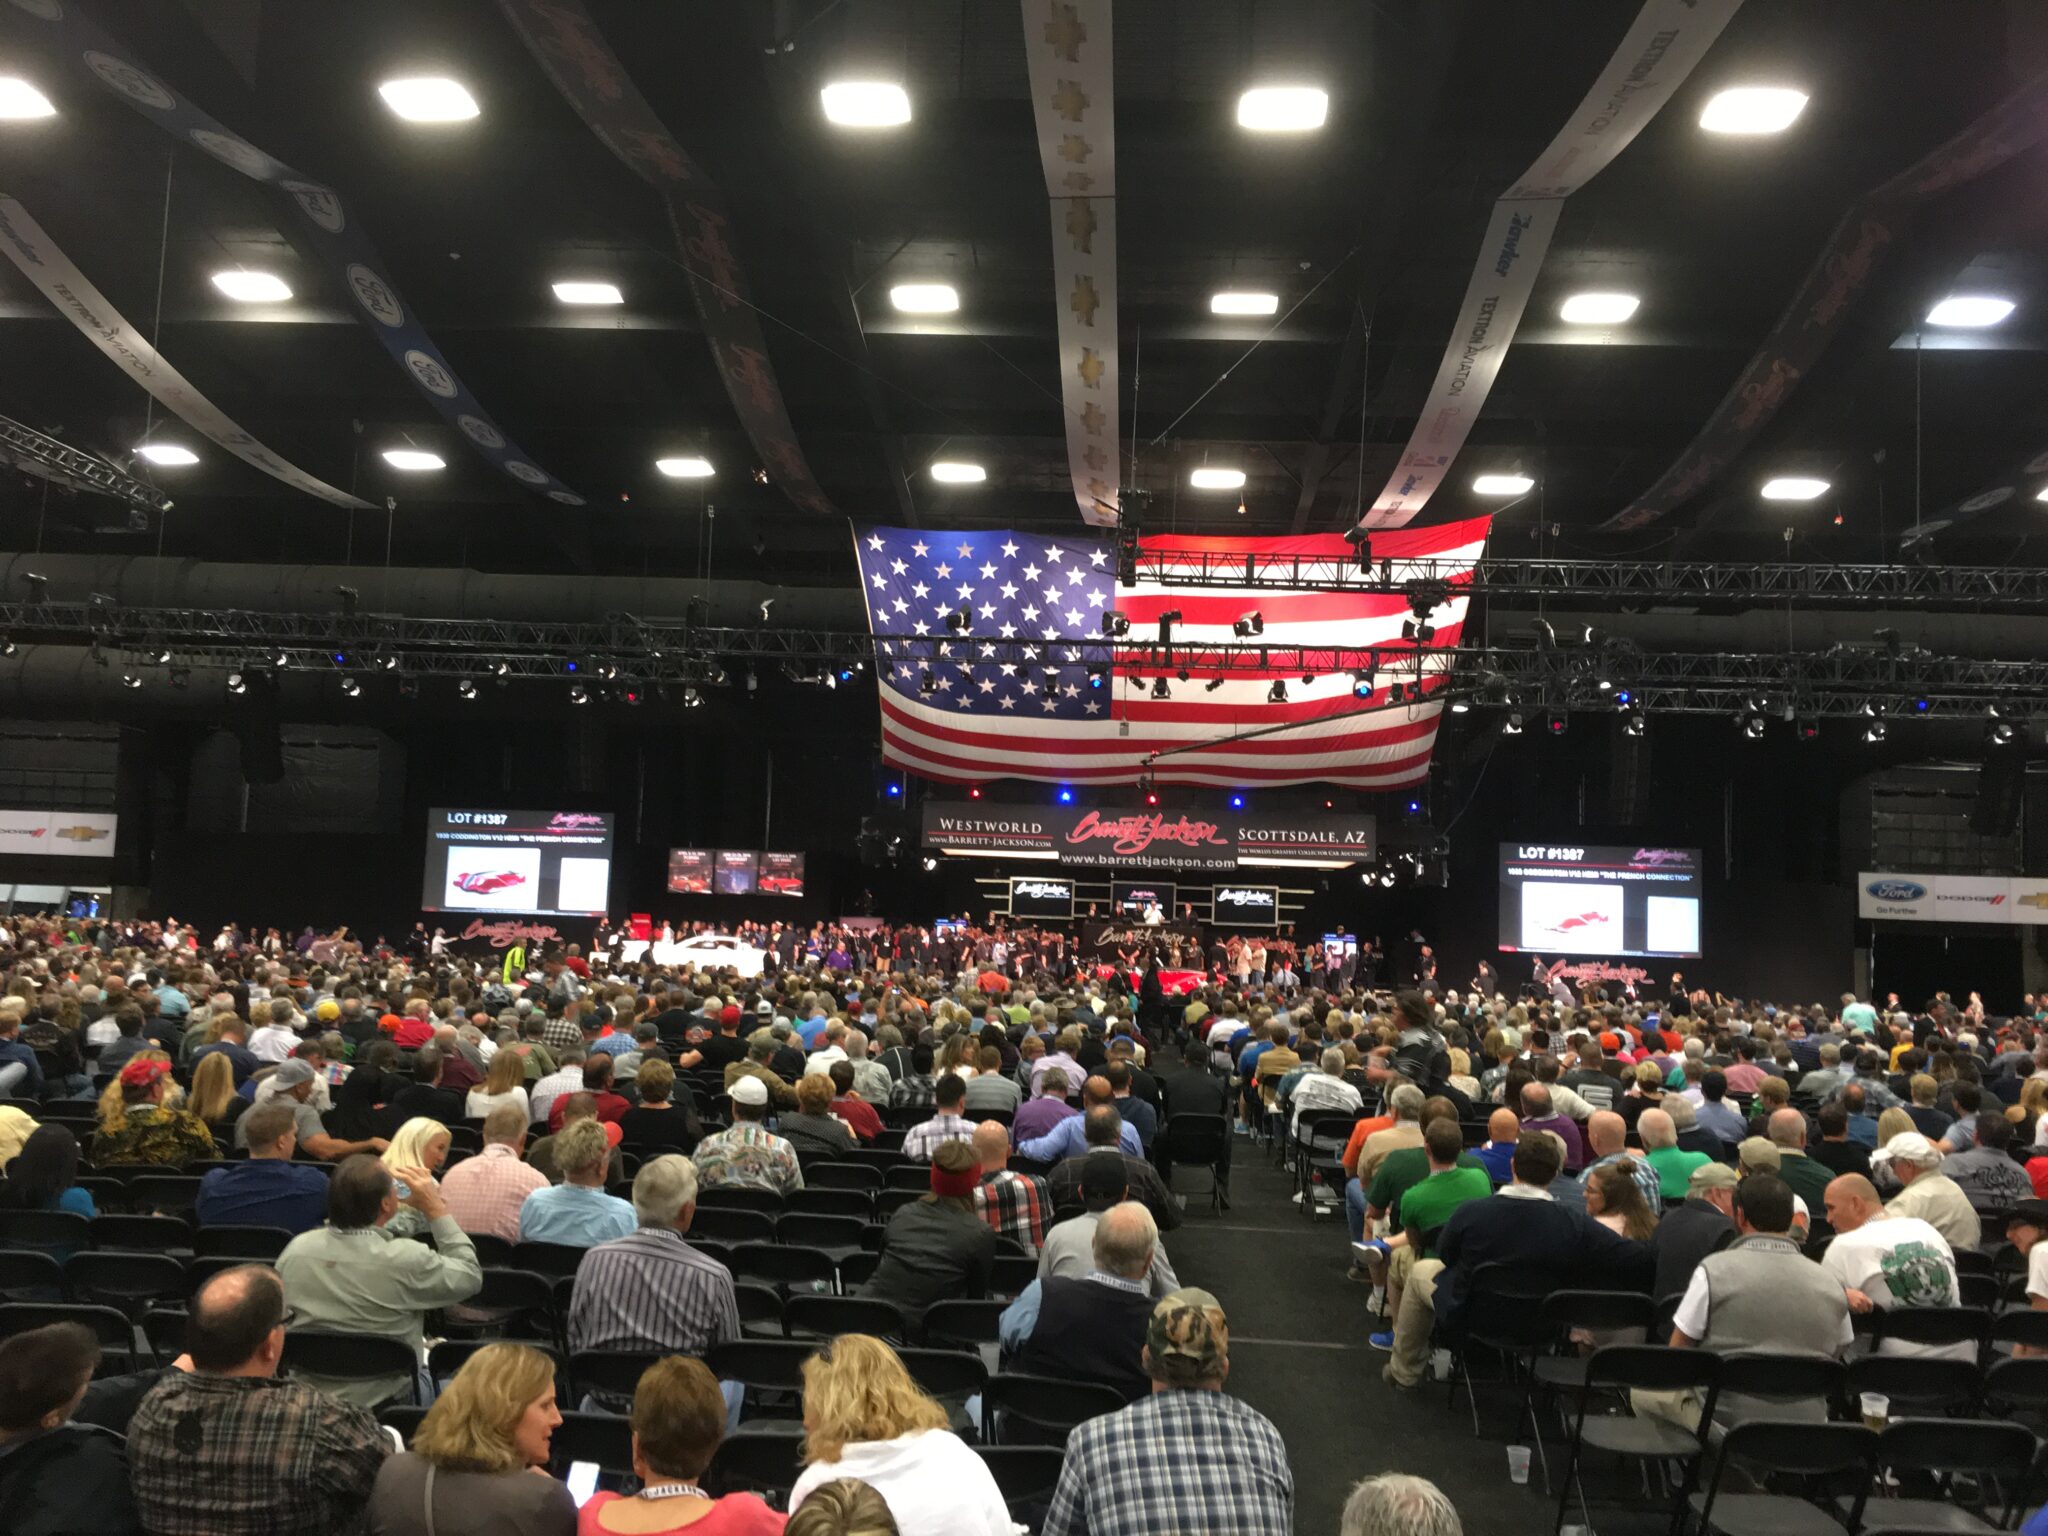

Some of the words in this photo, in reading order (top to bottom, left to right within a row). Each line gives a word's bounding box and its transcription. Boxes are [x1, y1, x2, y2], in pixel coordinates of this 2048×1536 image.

[354, 276, 394, 317] Ford
[1469, 295, 1499, 345] TEXTRON
[53, 283, 103, 329] TEXTRON
[101, 328, 157, 377] AVIATION
[411, 358, 449, 390] Ford
[1447, 344, 1482, 397] AVIATION
[447, 812, 472, 824] LOT
[474, 813, 508, 825] #1387
[939, 817, 1042, 834] WESTWORLD
[1238, 828, 1339, 844] SCOTTSDALE,
[1344, 831, 1365, 843] AZ
[1060, 854, 1236, 869] www.barrettjackson.com
[1519, 847, 1546, 859] LOT
[1547, 848, 1585, 861] #1387
[1877, 884, 1915, 899] Ford
[1936, 894, 1994, 902] DODGE
[1876, 906, 1888, 914] Go
[1888, 907, 1918, 915] Further
